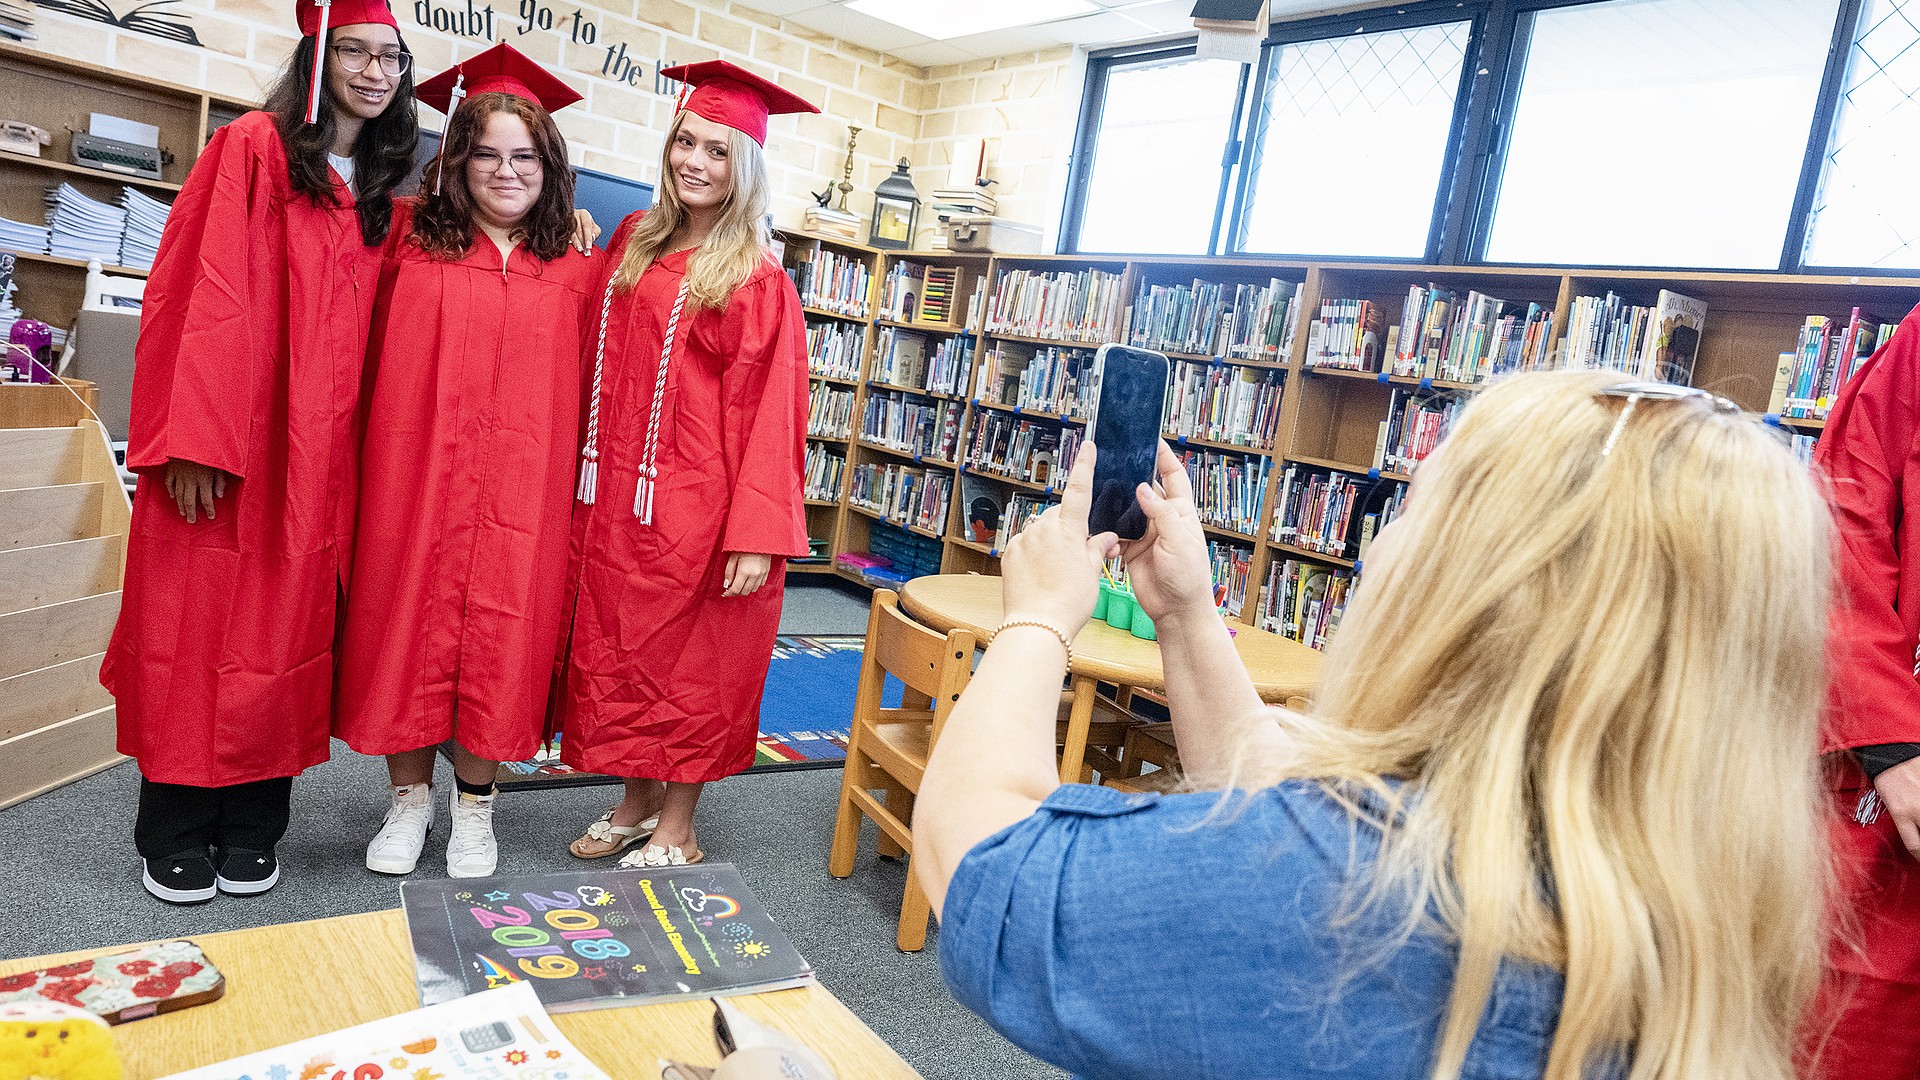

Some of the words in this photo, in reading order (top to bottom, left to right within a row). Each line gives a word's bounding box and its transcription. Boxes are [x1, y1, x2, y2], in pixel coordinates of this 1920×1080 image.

[517, 0, 553, 35] go
[571, 9, 597, 45] to
[601, 42, 643, 87] the
[469, 905, 580, 979] 2019
[522, 890, 631, 961] 2018
